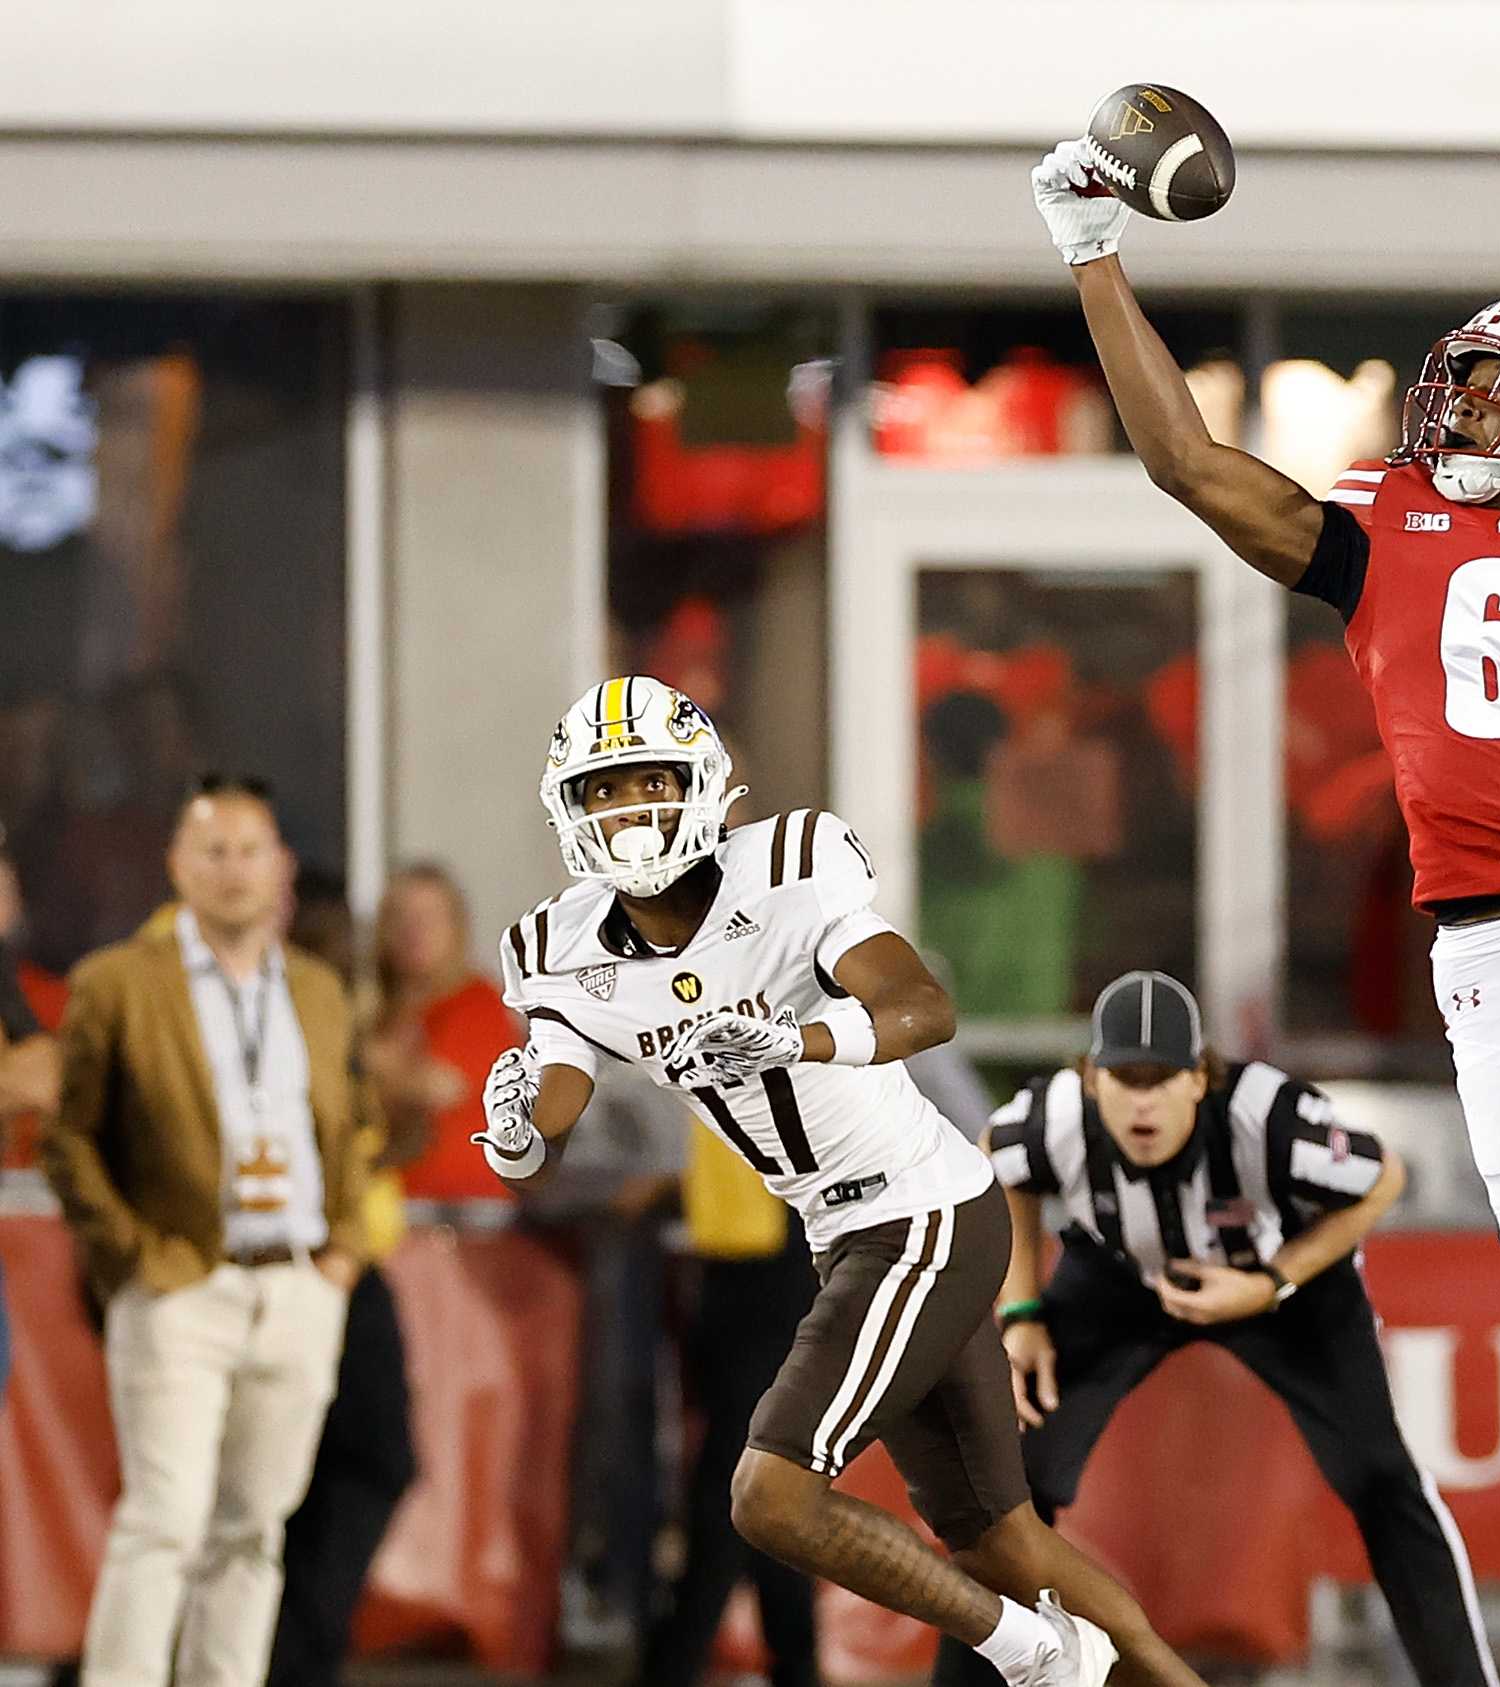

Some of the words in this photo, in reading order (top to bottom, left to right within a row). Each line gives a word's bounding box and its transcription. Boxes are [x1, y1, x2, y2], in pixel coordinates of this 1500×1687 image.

[724, 922, 761, 942] adidas
[673, 975, 699, 1002] W
[664, 1050, 820, 1176] 17
